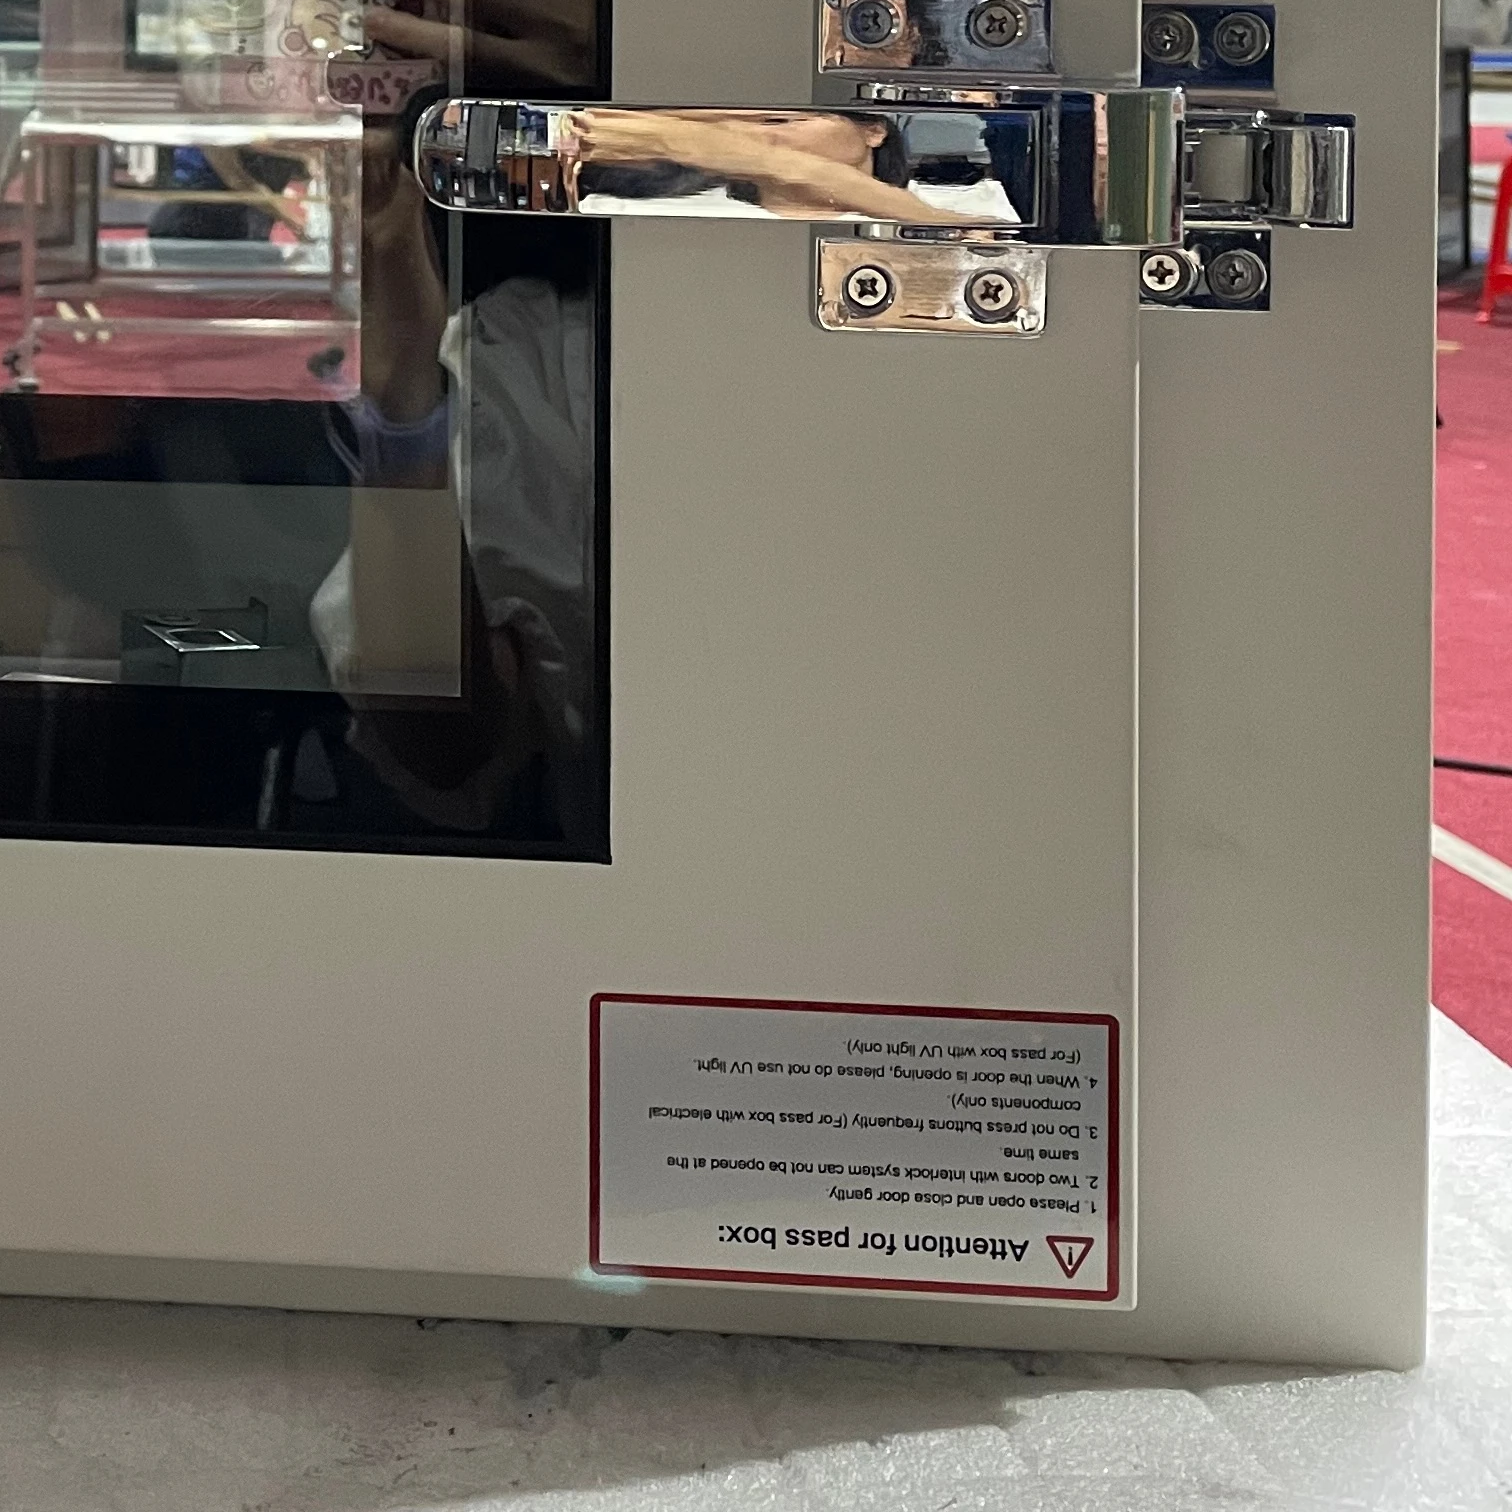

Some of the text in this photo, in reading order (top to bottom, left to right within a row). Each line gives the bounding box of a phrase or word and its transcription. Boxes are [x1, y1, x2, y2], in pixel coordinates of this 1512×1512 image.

[842, 1038, 1082, 1066] (For pass box with UV light only).
[692, 1056, 727, 1074] light.
[729, 1060, 754, 1075] UV
[756, 1061, 784, 1074] use
[787, 1063, 811, 1077] not
[813, 1064, 834, 1079] do
[836, 1064, 886, 1080] please
[888, 1064, 953, 1082] opening,
[955, 1070, 969, 1084] is
[970, 1071, 1006, 1086] door
[1008, 1072, 1033, 1087] the
[1035, 1073, 1081, 1090] When
[946, 1092, 1082, 1112] components only).
[647, 1106, 713, 1122] electrical
[715, 1109, 746, 1124] with
[747, 1110, 776, 1126] box
[778, 1110, 815, 1125] pass
[816, 1112, 849, 1130] (For
[851, 1112, 925, 1133] frequently
[927, 1118, 983, 1135] buttons
[986, 1120, 1028, 1135] press
[1030, 1122, 1056, 1137] not
[1058, 1124, 1081, 1140] Do
[999, 1146, 1080, 1162] same time.
[666, 1155, 690, 1170] the
[692, 1156, 707, 1170] at
[710, 1157, 766, 1172] opened
[768, 1160, 788, 1176] be
[789, 1161, 814, 1176] not
[817, 1163, 845, 1175] can
[847, 1162, 901, 1179] system
[903, 1166, 966, 1184] interlock
[969, 1169, 1000, 1184] with
[1002, 1171, 1046, 1187] doors
[1048, 1173, 1081, 1190] Two
[825, 1184, 874, 1202] gently.
[875, 1190, 911, 1205] door
[913, 1192, 954, 1208] close
[956, 1193, 985, 1208] and
[987, 1194, 1026, 1209] open
[1028, 1197, 1081, 1215] Please
[717, 1224, 1030, 1263] Attention for pass box:
